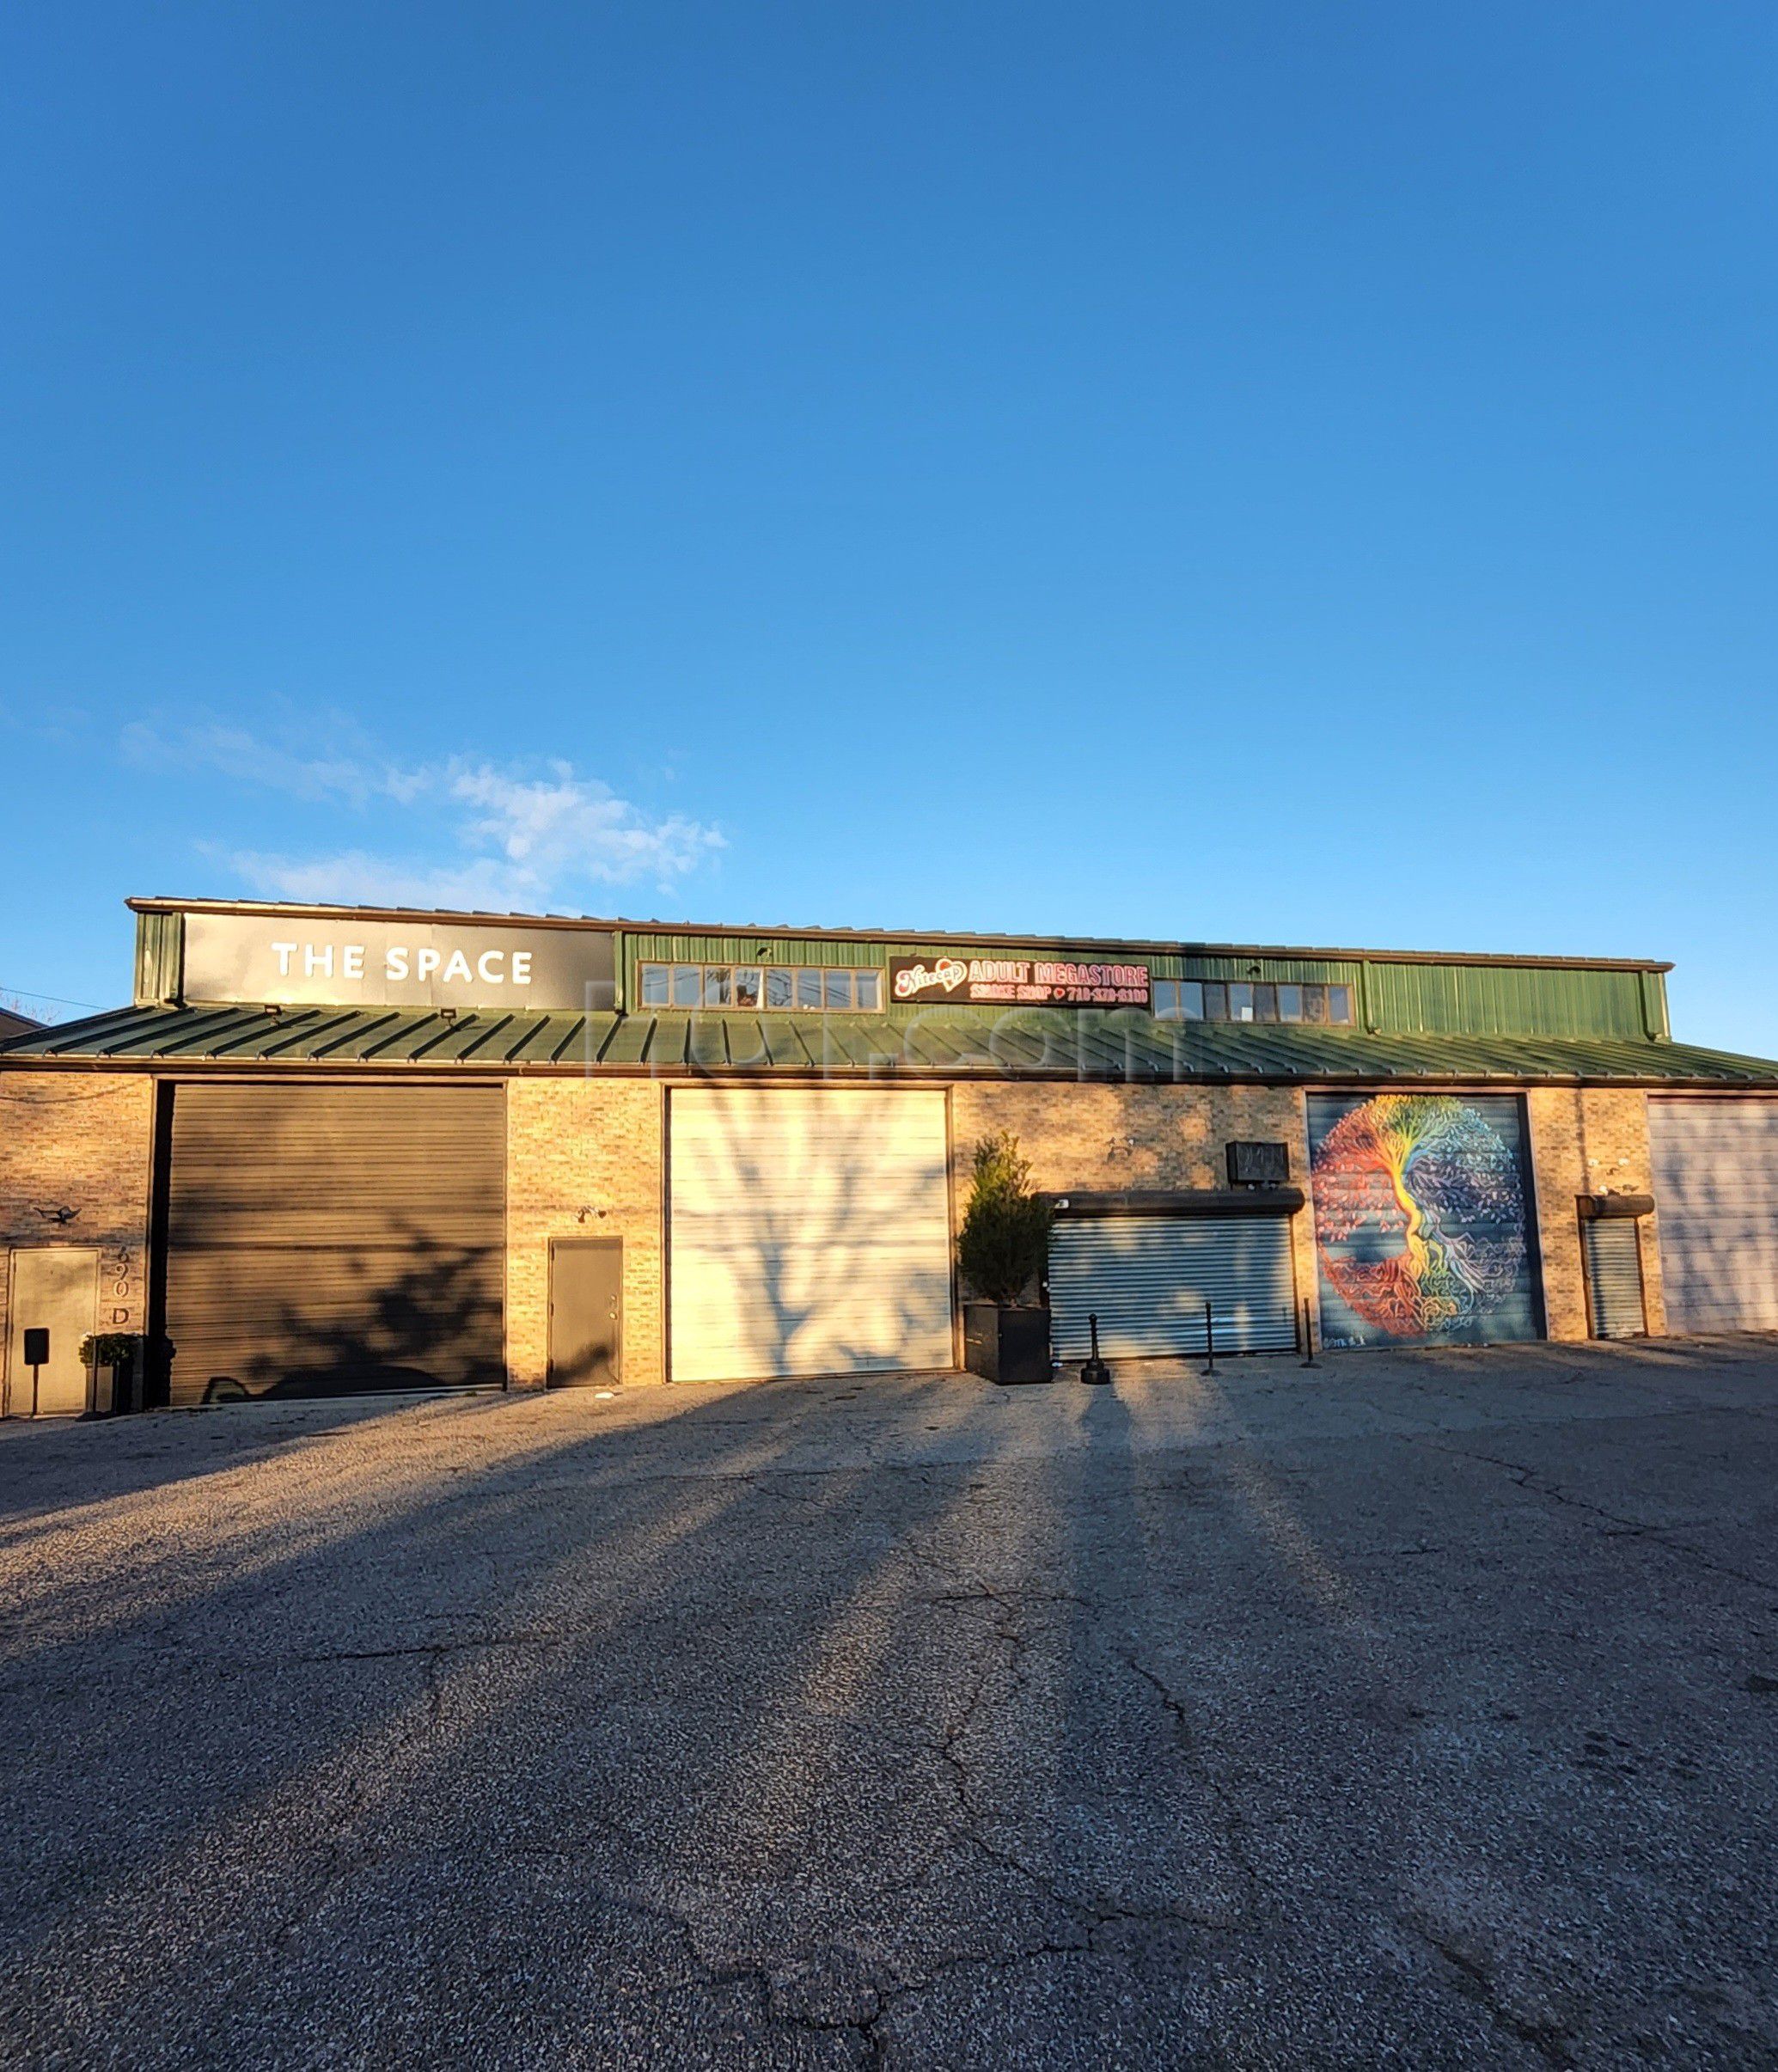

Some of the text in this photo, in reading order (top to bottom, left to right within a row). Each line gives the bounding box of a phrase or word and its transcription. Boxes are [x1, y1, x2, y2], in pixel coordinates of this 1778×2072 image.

[271, 942, 532, 985] THE SPACE
[968, 960, 1149, 987] ADULT MEGASTORE
[1017, 985, 1052, 1000] SHOP
[113, 1308, 130, 1324] D
